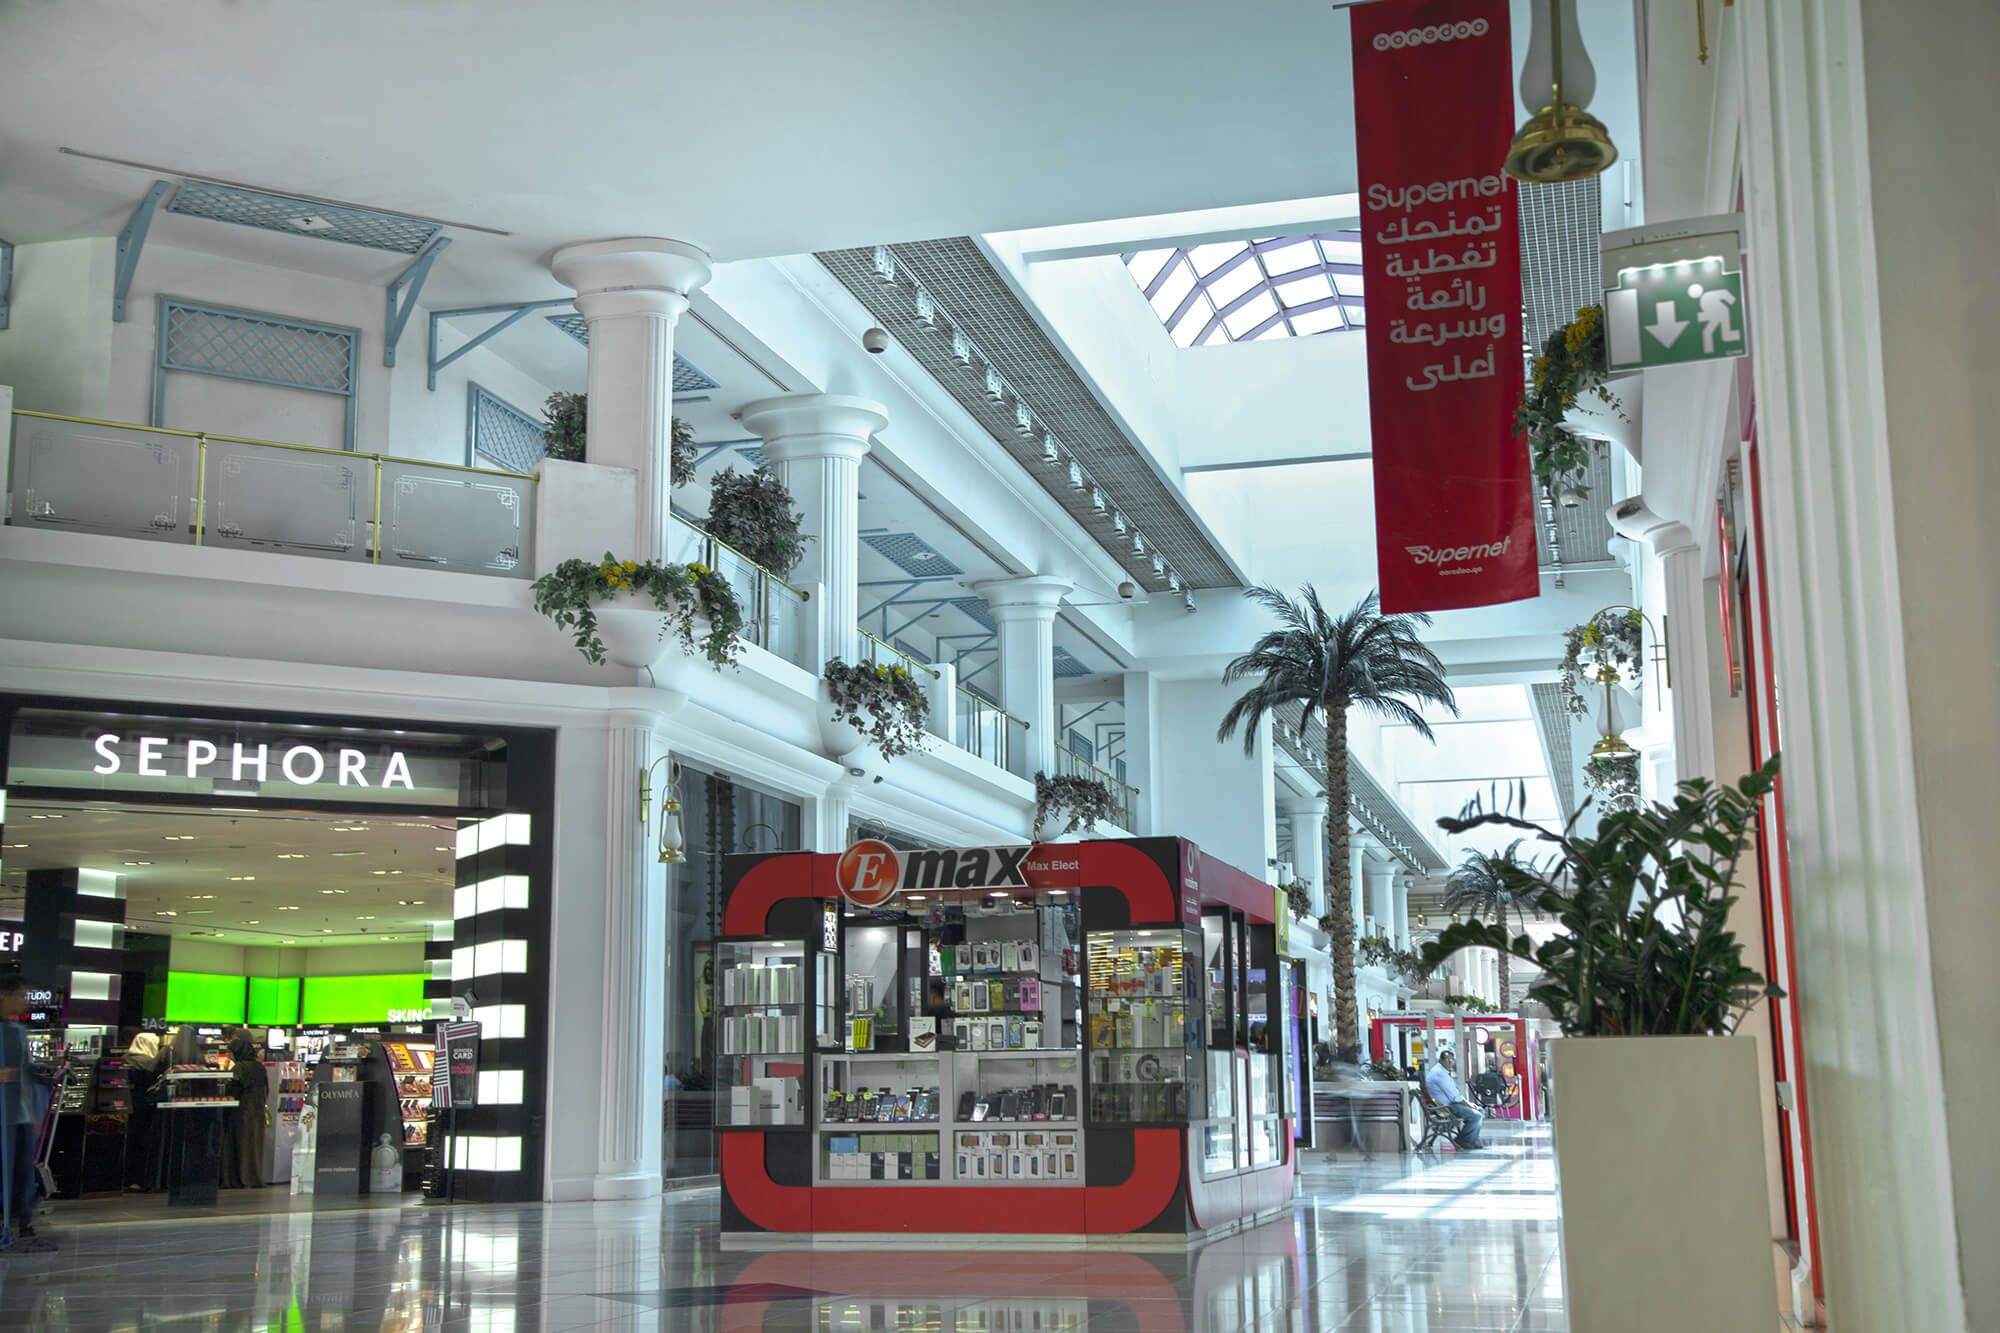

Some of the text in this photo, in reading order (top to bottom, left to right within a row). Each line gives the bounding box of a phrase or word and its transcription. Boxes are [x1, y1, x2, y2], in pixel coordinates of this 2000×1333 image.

[1373, 18, 1489, 51] ooredoo
[1367, 168, 1507, 212] Supernet
[1377, 205, 1502, 245] تمنحك
[1385, 241, 1497, 282] تغطية
[1407, 278, 1486, 310] رائعة
[1389, 313, 1506, 346] وسرعة
[1406, 344, 1495, 391] أعلى
[1404, 536, 1511, 567] Supernet
[93, 733, 415, 790] SEPHORA
